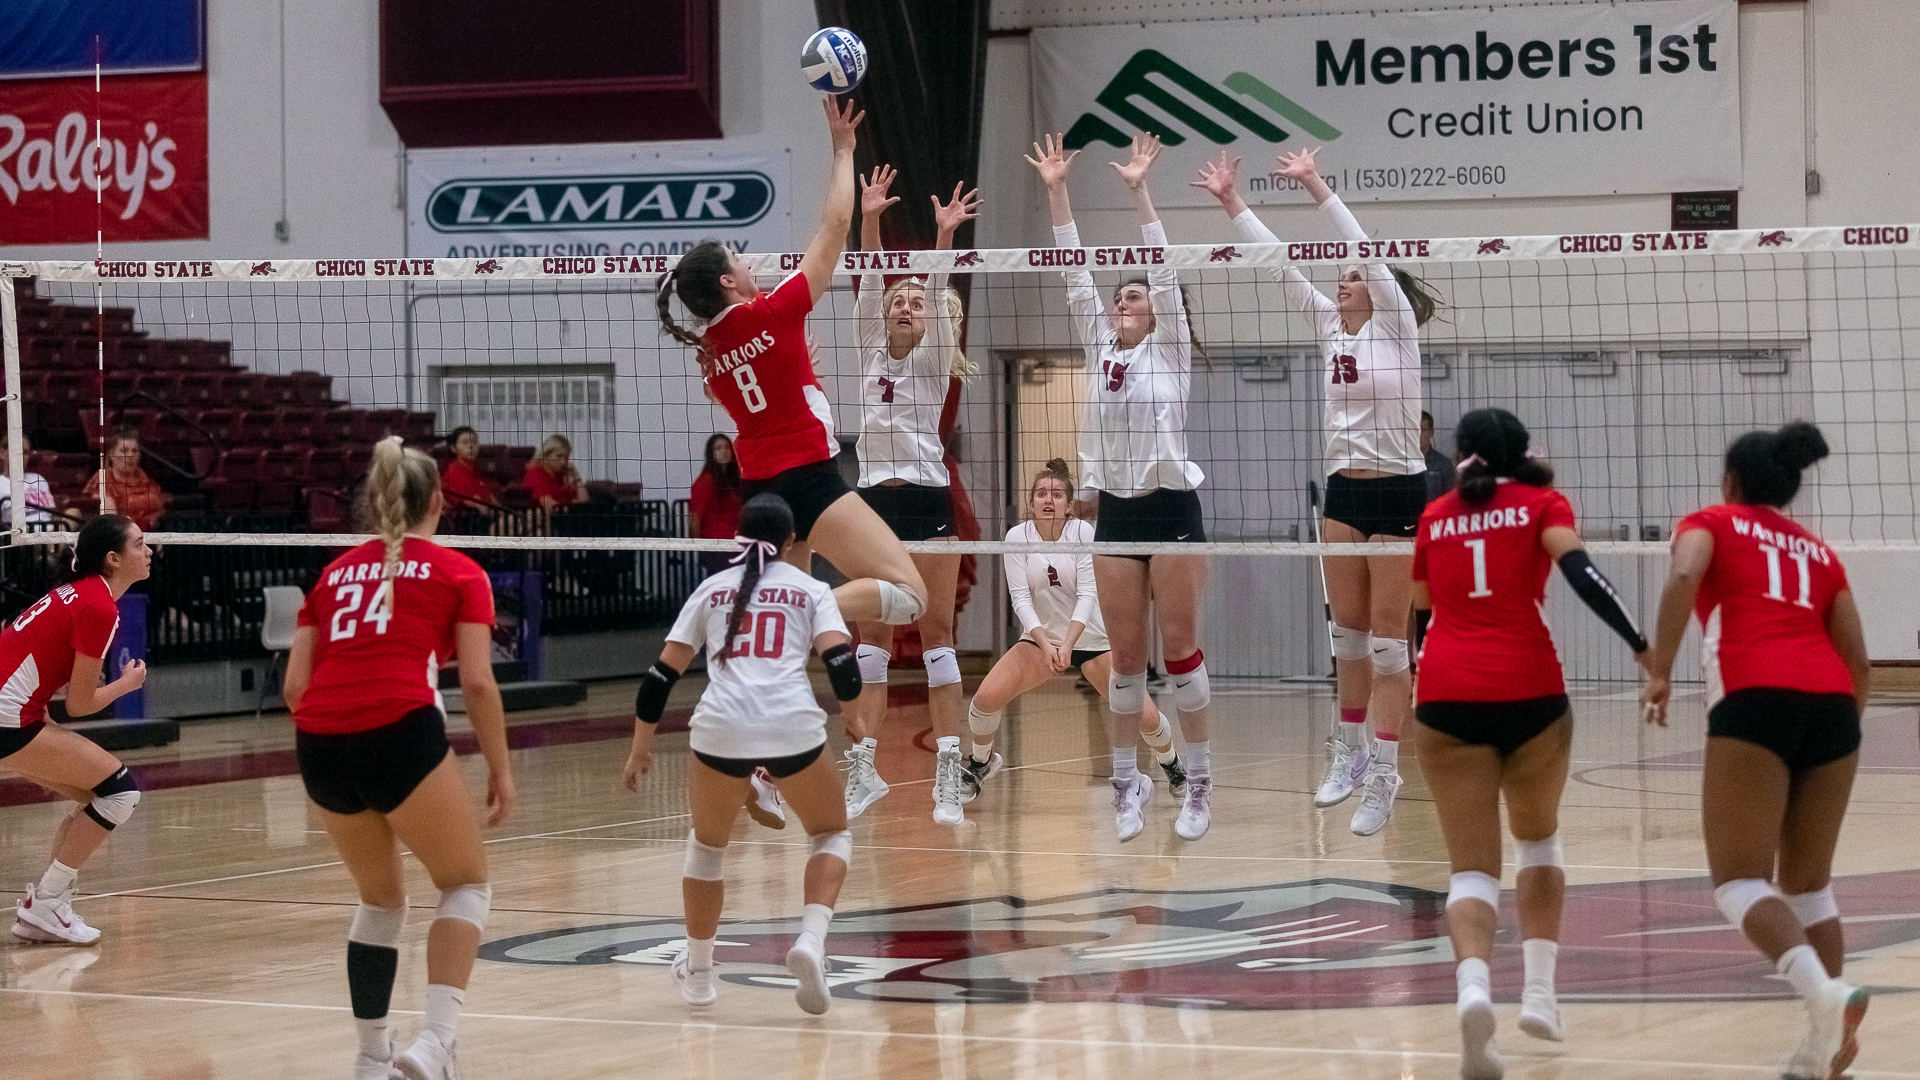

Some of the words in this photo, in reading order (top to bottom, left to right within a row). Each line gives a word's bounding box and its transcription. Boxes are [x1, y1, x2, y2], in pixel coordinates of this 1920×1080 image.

[834, 43, 856, 74] NCAA
[843, 36, 863, 72] molten
[1314, 31, 1616, 87] Members
[1633, 24, 1717, 75] 1st
[1387, 102, 1513, 139] Credit
[1526, 98, 1644, 133] Union
[456, 181, 737, 224] LAMAR
[1287, 242, 1348, 260] CHICO
[1357, 240, 1430, 259] STATE
[1559, 234, 1622, 254] CHICO
[1632, 232, 1708, 251] STATE
[1843, 226, 1909, 246] CHICO
[98, 261, 147, 278] CHICO
[154, 261, 213, 278] STATE
[315, 260, 368, 277] CHICO
[376, 259, 435, 277] STATE
[543, 257, 596, 275] CHICO
[604, 256, 668, 273] STATE
[844, 252, 910, 270] STATE
[1028, 249, 1086, 267] CHICO
[1094, 247, 1165, 265] STATE
[713, 330, 775, 376] ARRIORS
[1332, 354, 1358, 384] 13
[732, 363, 768, 414] 8
[878, 376, 896, 403] 7
[1103, 359, 1130, 392] 15
[1429, 506, 1530, 541] WARRIORS
[1731, 516, 1830, 566] WARRIORS
[1047, 565, 1062, 587] 2
[1463, 538, 1493, 599] 1
[1758, 542, 1815, 611] 11
[330, 580, 394, 642] 24
[758, 588, 807, 609] STATE
[725, 610, 786, 659] 20
